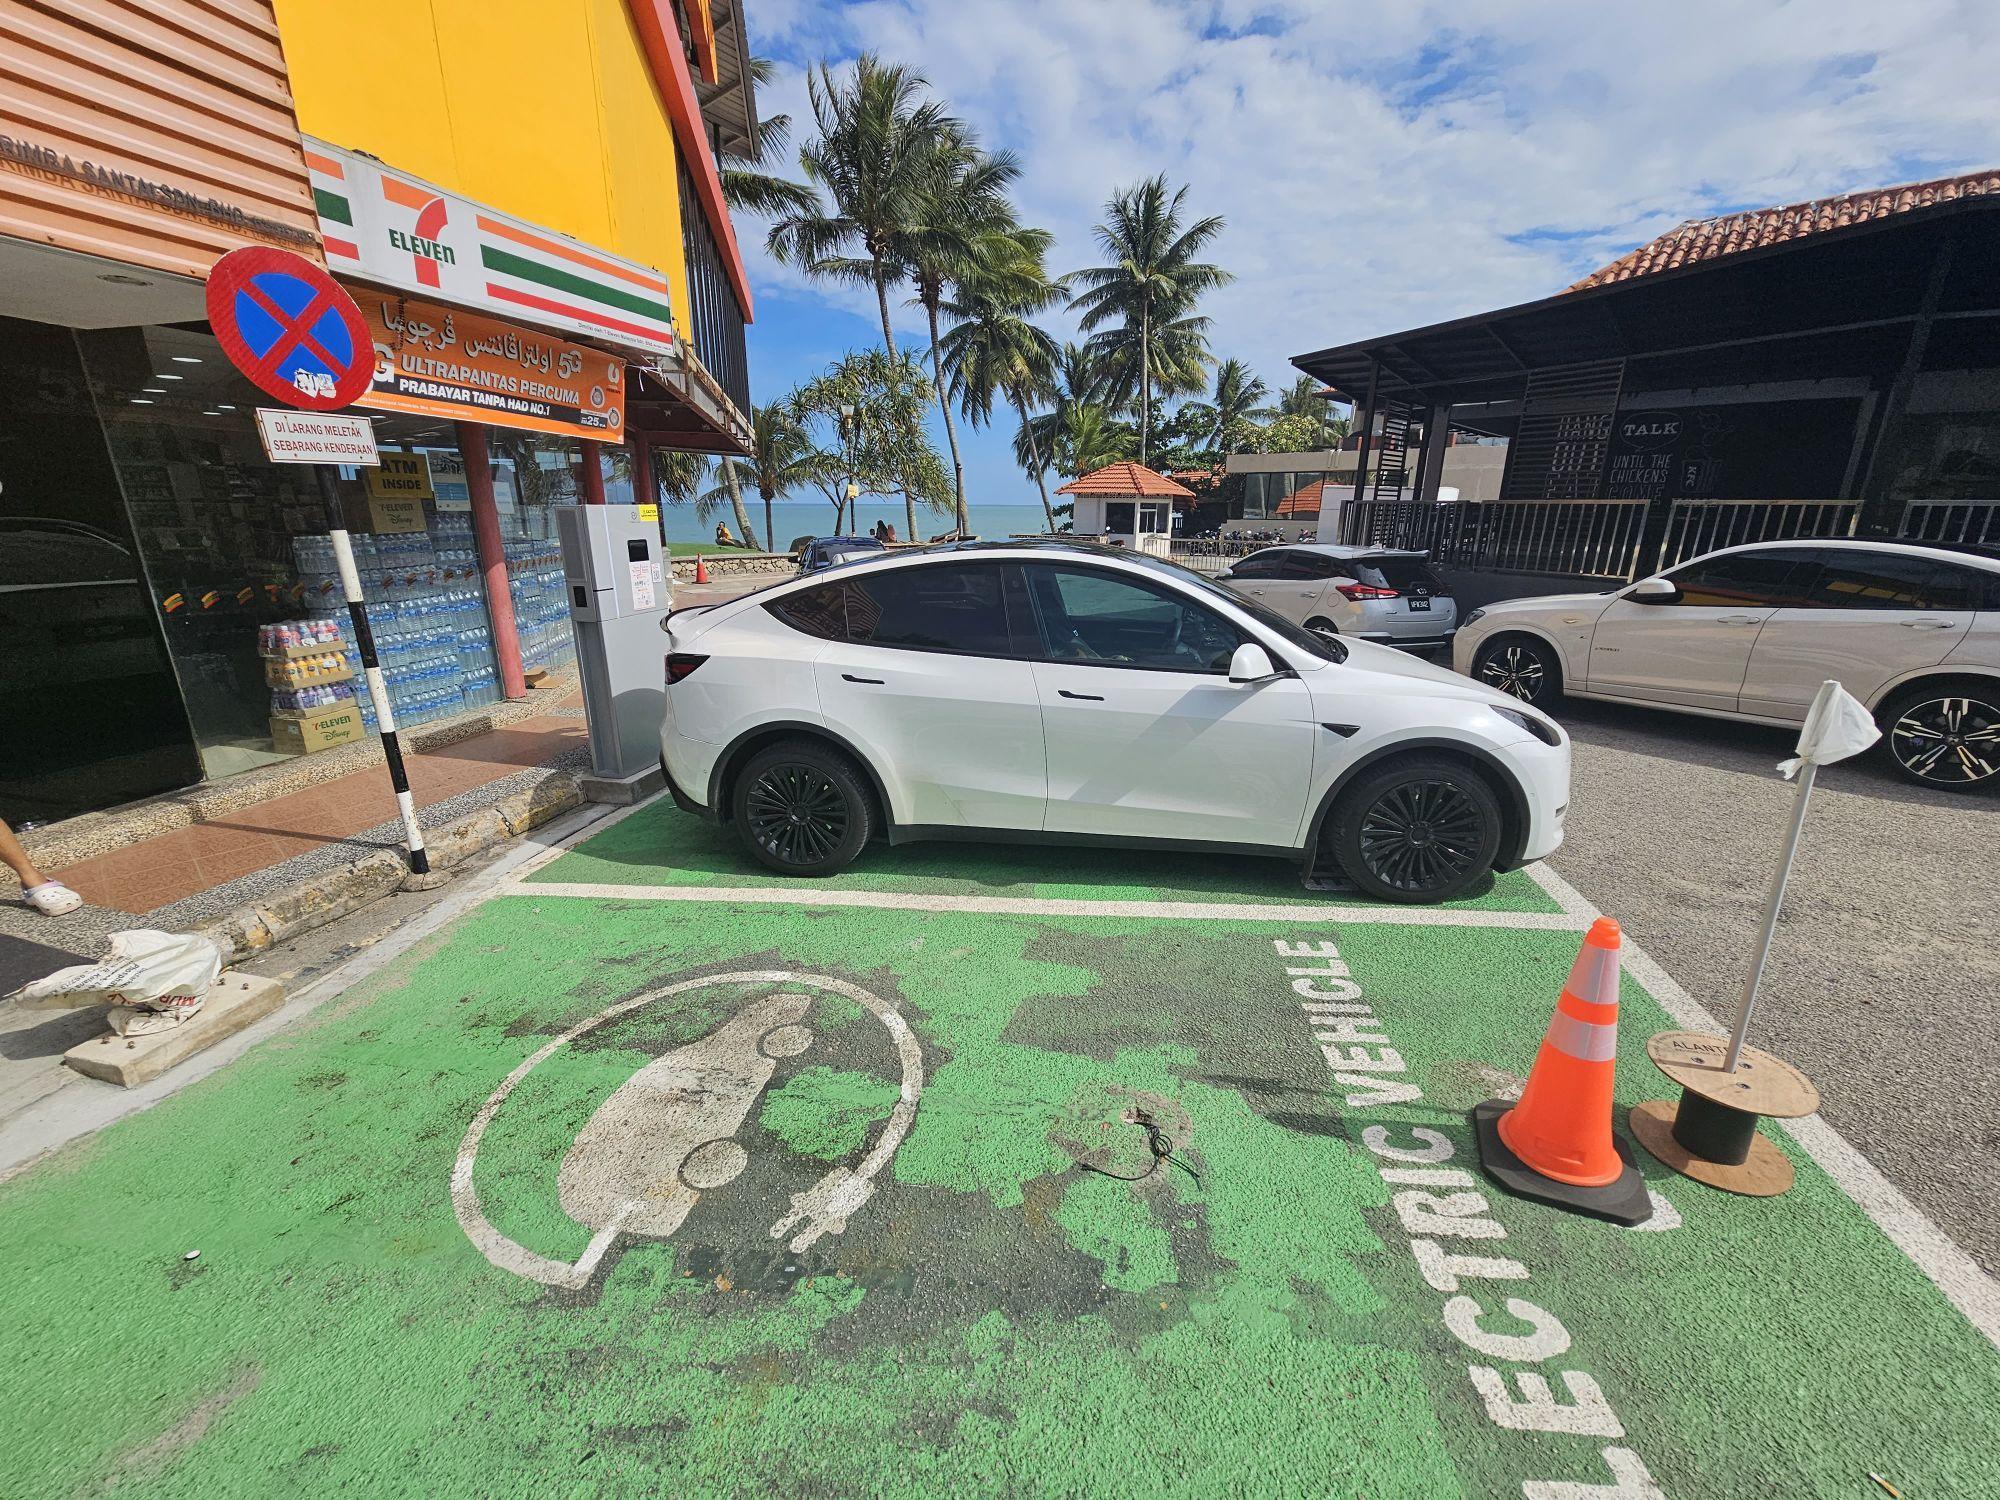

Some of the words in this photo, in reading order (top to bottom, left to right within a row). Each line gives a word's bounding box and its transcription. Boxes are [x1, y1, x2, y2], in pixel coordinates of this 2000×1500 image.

[401, 353, 517, 392] ULTRAPANTAS
[519, 379, 580, 406] PERCUMA
[399, 378, 470, 402] PRABAYAR
[472, 391, 507, 409] TANPA
[508, 399, 529, 414] HAD
[530, 404, 550, 416] NO.1
[287, 421, 324, 436] LARANG
[324, 424, 363, 438] MELETAK
[1623, 421, 1681, 436] TALK
[273, 439, 323, 453] SEBARANG
[324, 441, 373, 455] KENDERAAN
[380, 460, 418, 474] ATM
[1612, 455, 1645, 469] UNTIL
[1652, 454, 1674, 469] THE
[1609, 469, 1668, 483] CHICKENS
[382, 478, 422, 490] INSIDE
[319, 730, 351, 742] Disney
[1273, 939, 1424, 1107] VEHICLE
